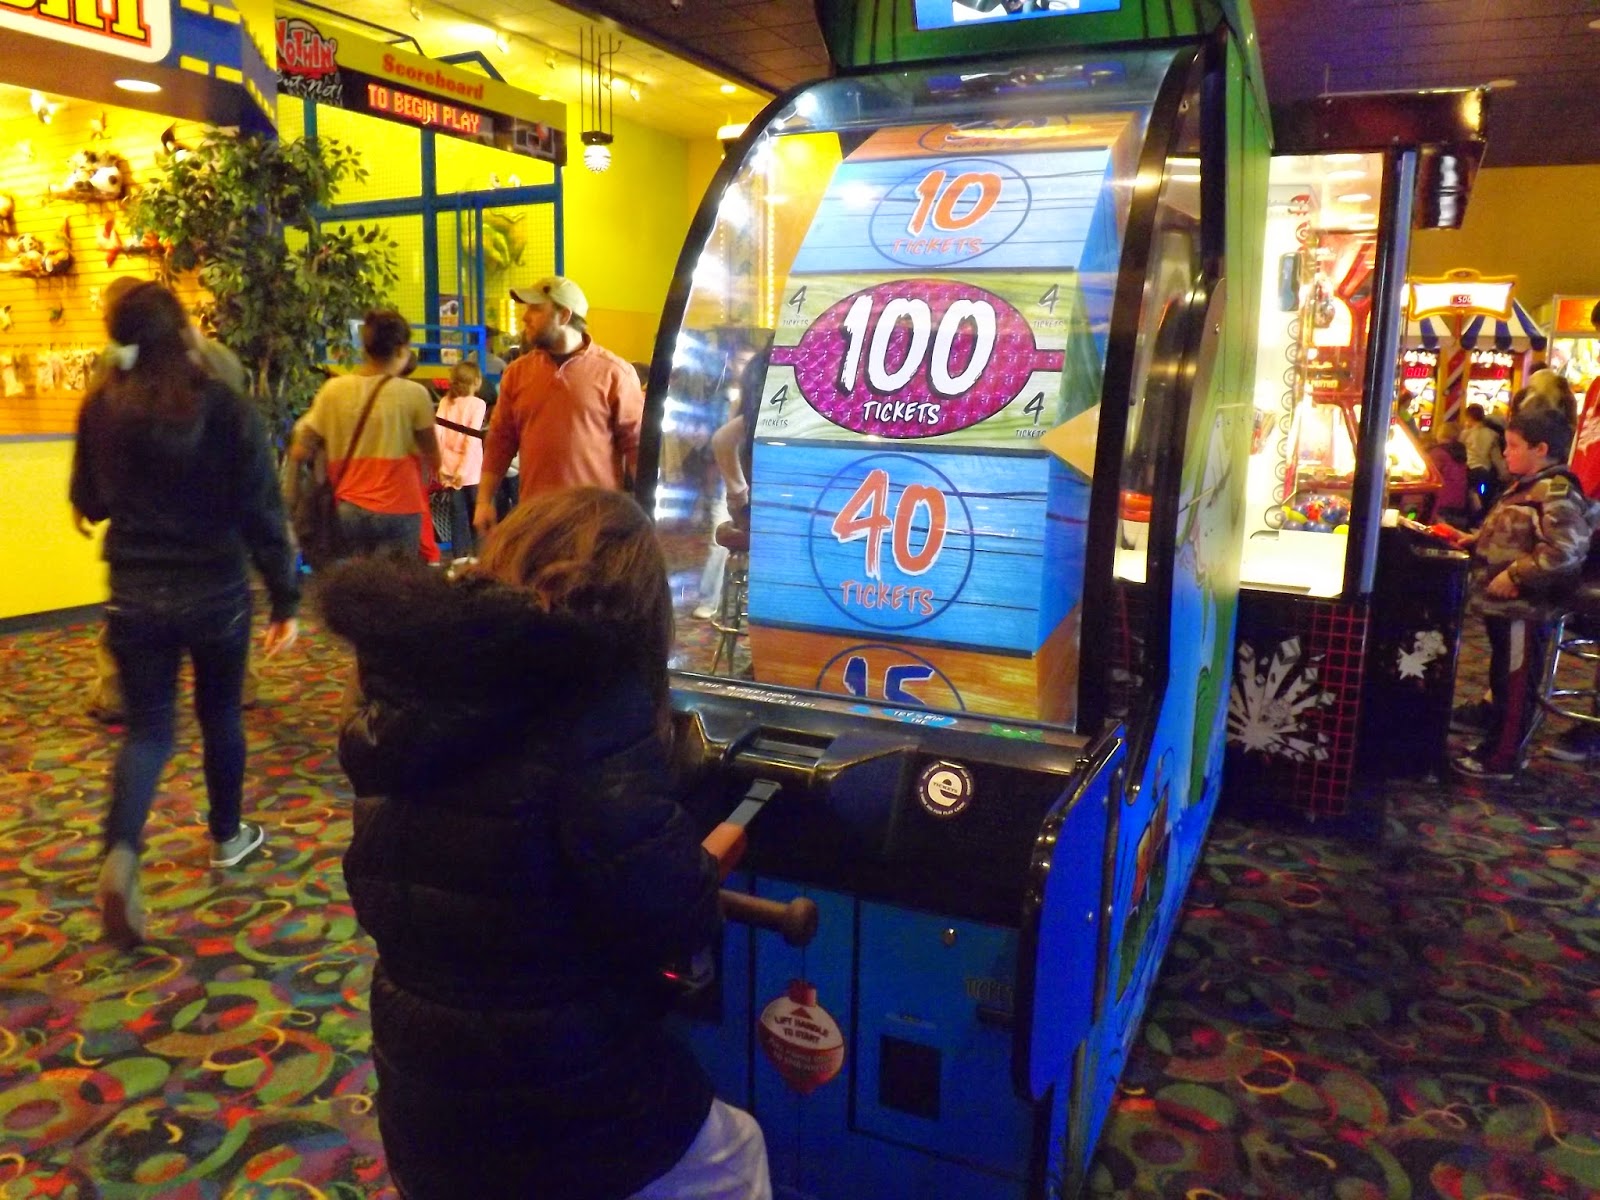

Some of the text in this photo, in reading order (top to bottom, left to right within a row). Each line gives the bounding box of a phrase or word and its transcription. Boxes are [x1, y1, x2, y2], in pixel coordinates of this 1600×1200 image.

[381, 53, 485, 101] Scoreboard
[367, 82, 482, 134] TO BEGIN PLAY
[906, 169, 1003, 237] 10
[891, 236, 984, 256] TICKETS
[788, 285, 808, 315] 4
[1037, 282, 1061, 315] 4
[836, 294, 997, 398] 100
[769, 383, 789, 415] 4
[862, 400, 941, 425] TICKETS
[1022, 391, 1046, 427] 4
[761, 418, 789, 428] TICKETS
[830, 468, 948, 581] 40
[840, 579, 935, 616] TICKETS
